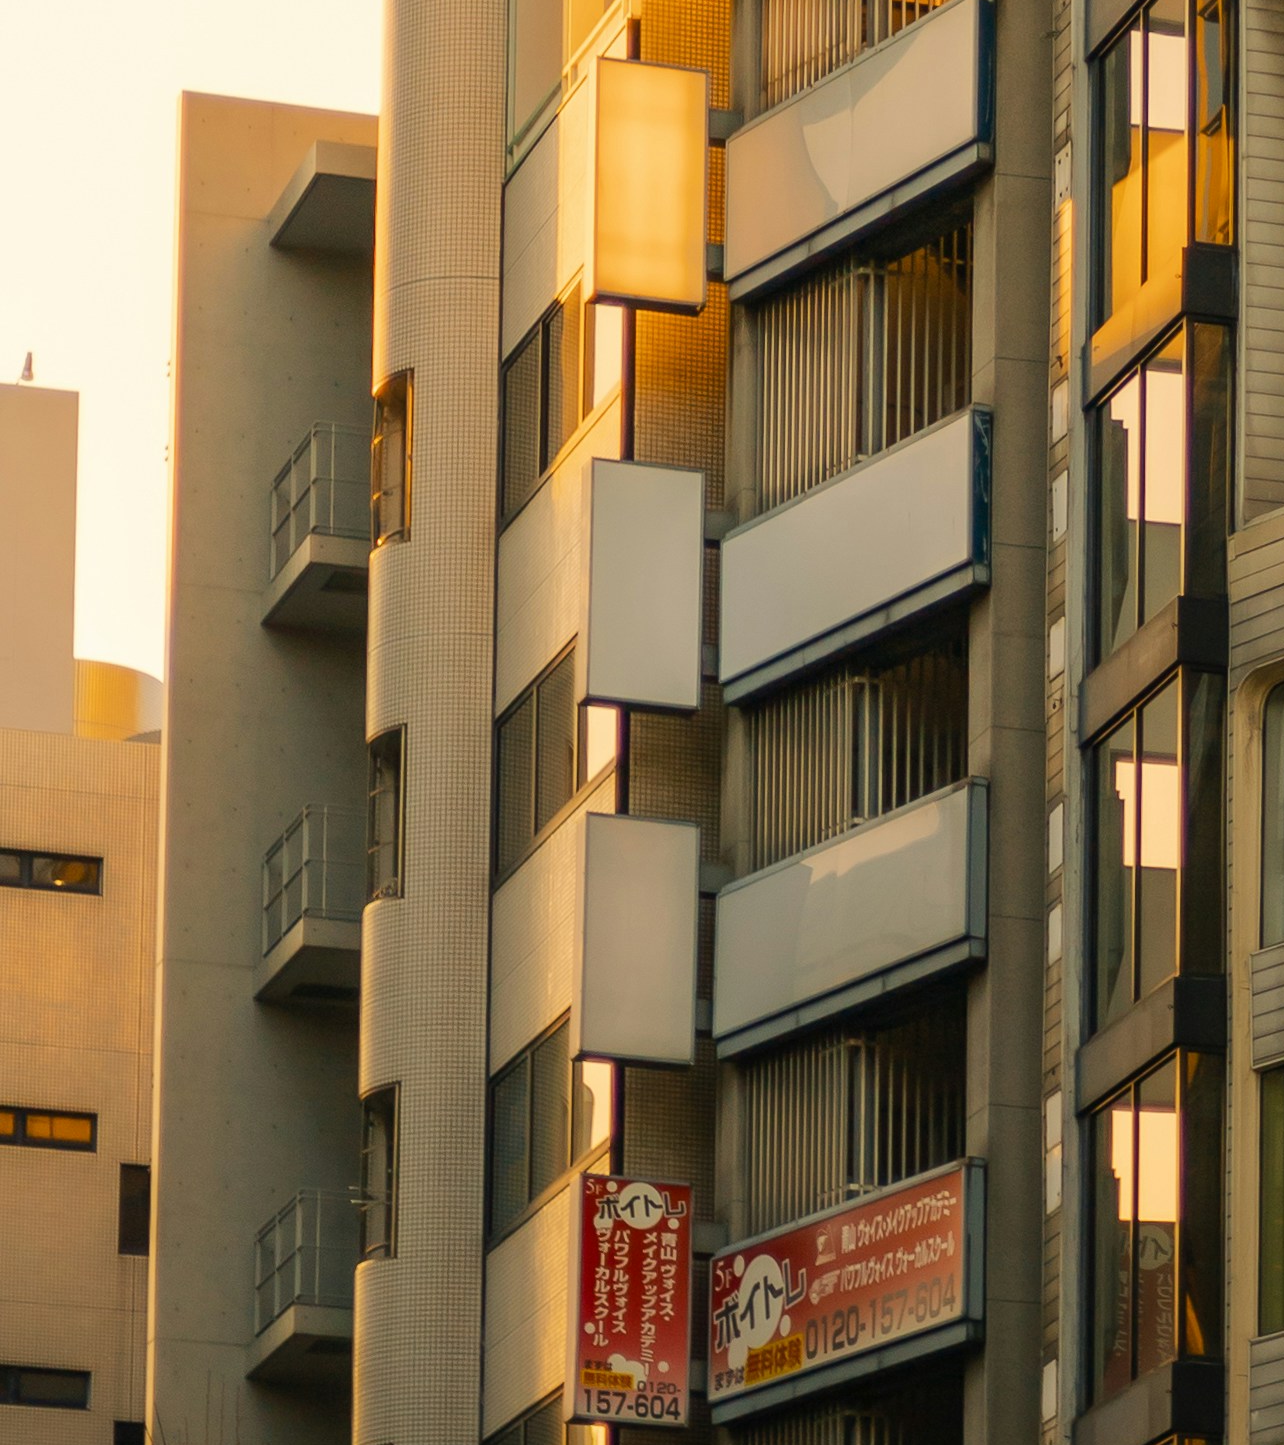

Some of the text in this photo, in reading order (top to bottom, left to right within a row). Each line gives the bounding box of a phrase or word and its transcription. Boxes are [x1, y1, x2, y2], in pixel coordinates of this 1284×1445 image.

[596, 1191, 686, 1219] ボイトレ
[714, 1262, 733, 1293] 5F
[714, 1259, 806, 1353] ボイトレ
[805, 1273, 957, 1360] 0120-157-604
[714, 1366, 744, 1391] まずは
[584, 1390, 681, 1420] 157-604
